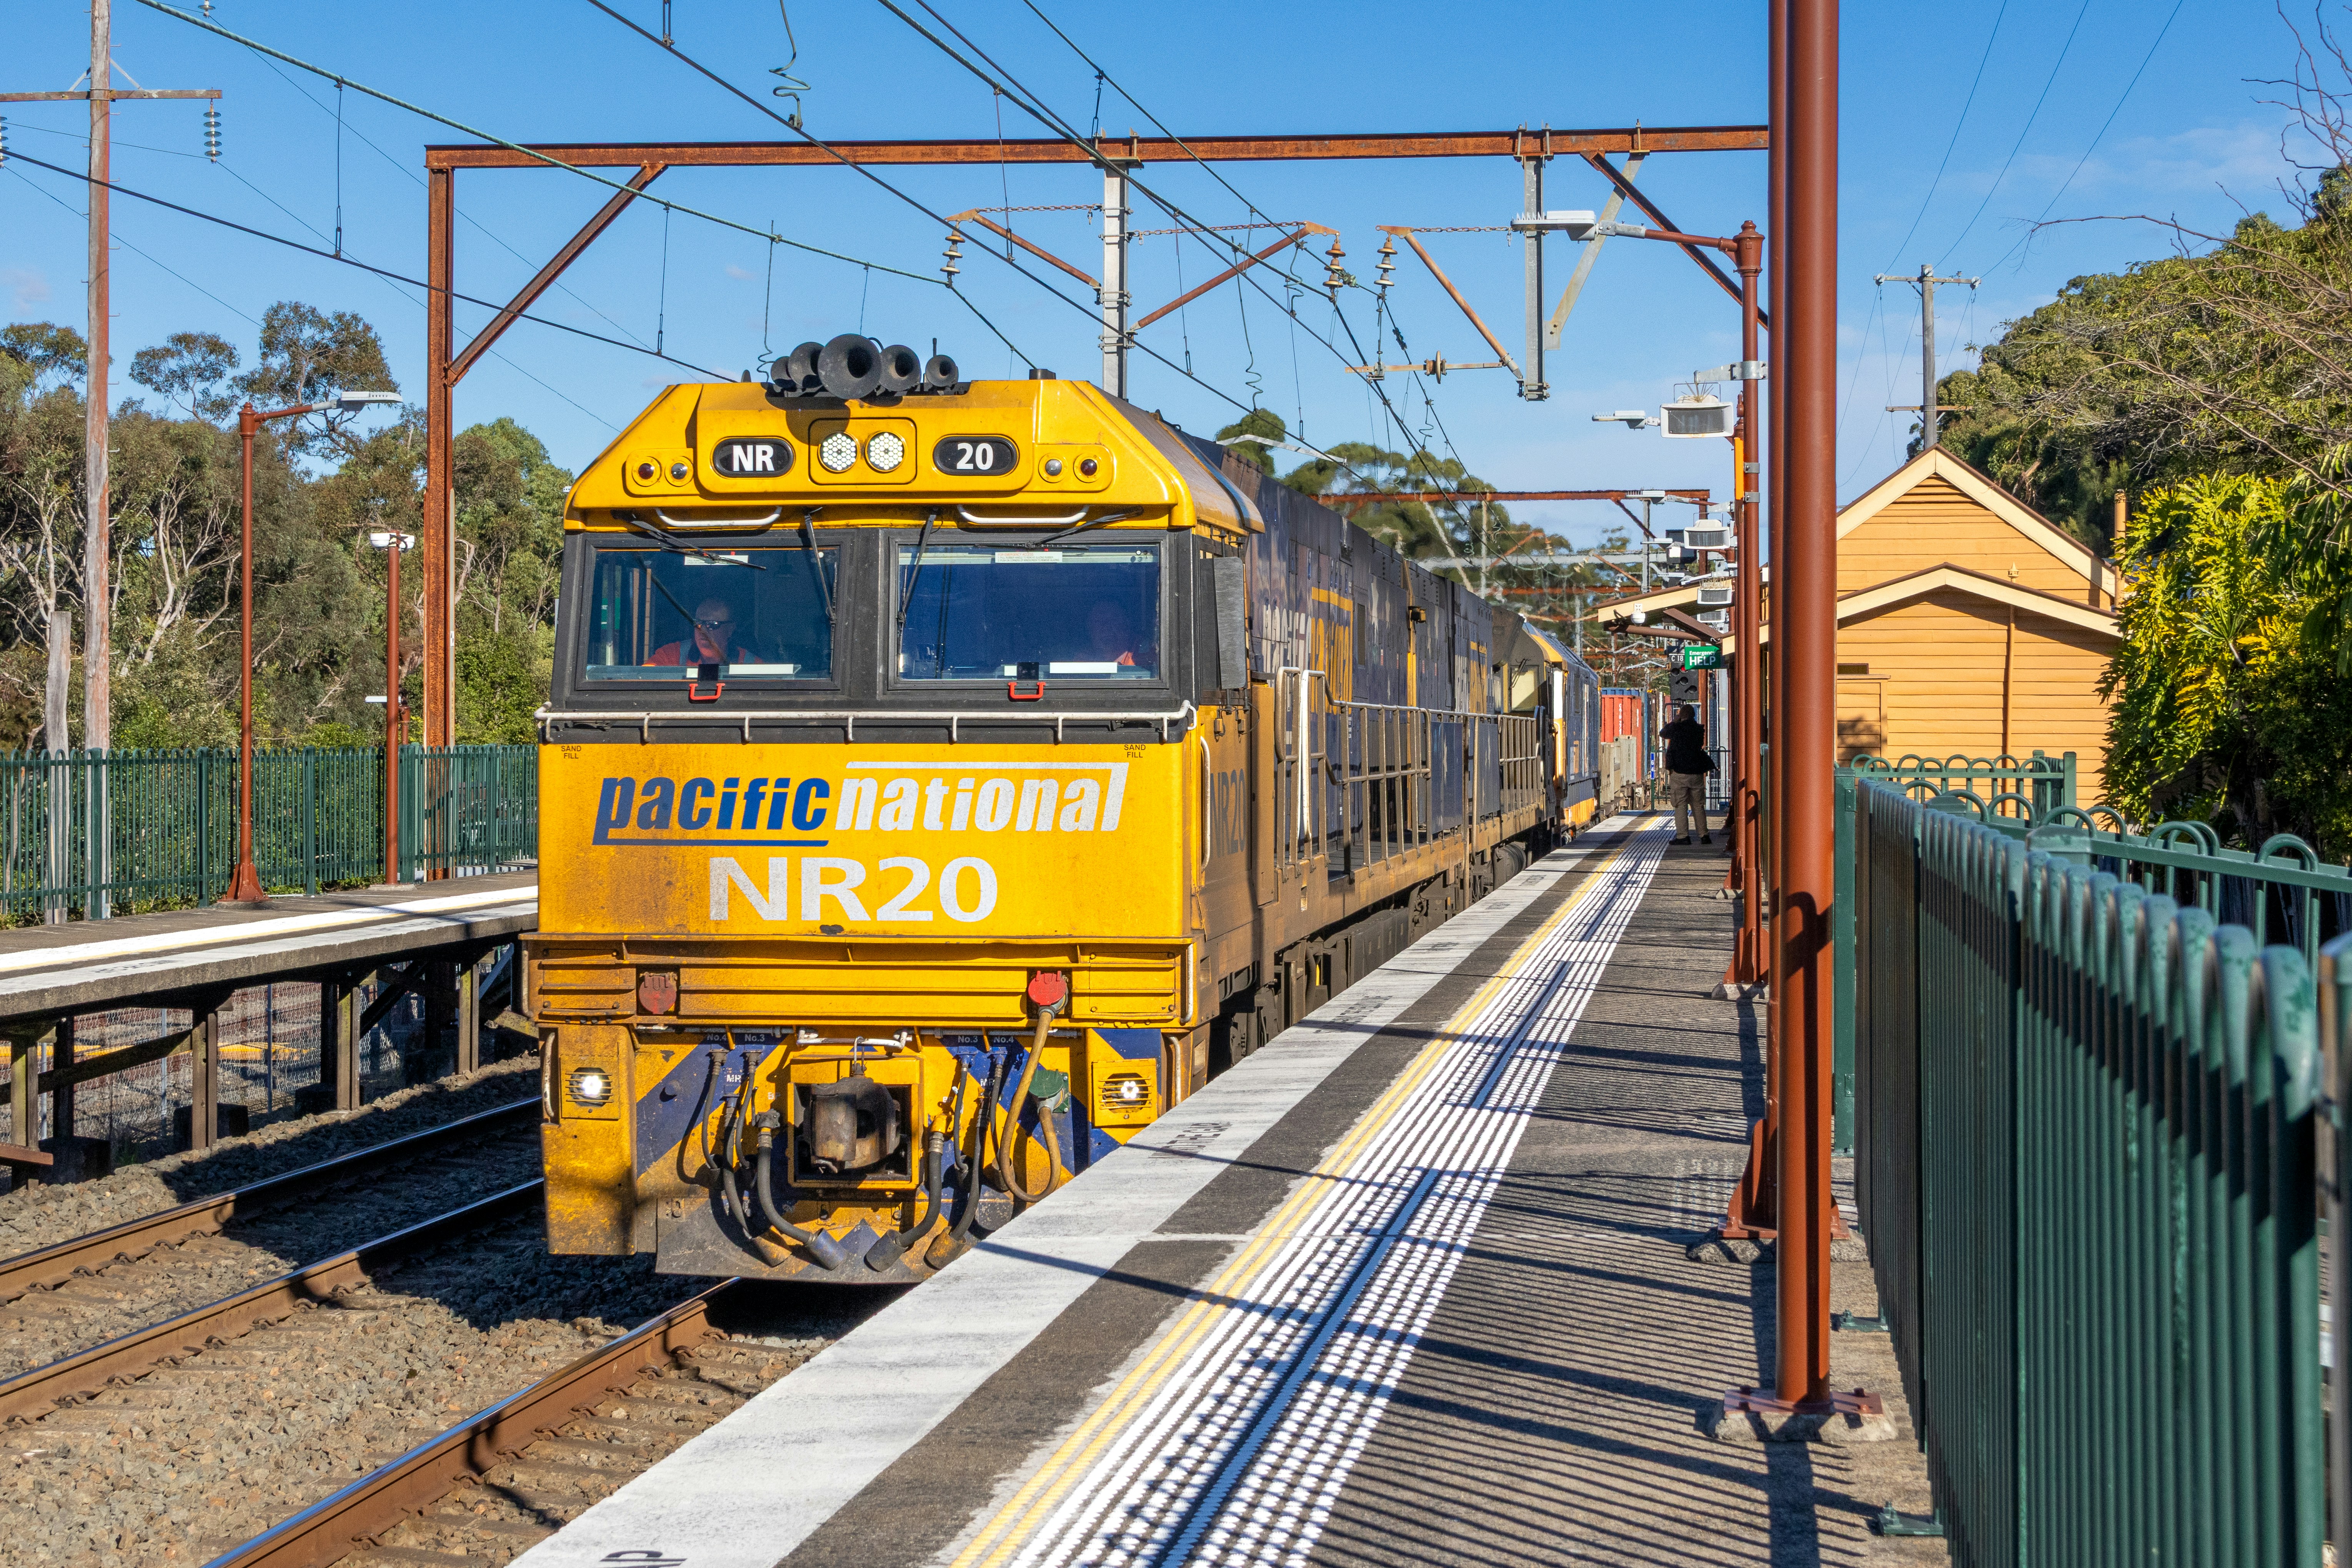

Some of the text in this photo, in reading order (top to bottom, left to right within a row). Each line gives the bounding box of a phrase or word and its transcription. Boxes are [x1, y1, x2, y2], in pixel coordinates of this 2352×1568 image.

[732, 445, 774, 472] NR
[956, 443, 993, 470] 20
[1689, 656, 1716, 666] HELP
[591, 762, 1129, 846] pacific national
[1210, 768, 1247, 858] NR20
[709, 856, 998, 921] NR20
